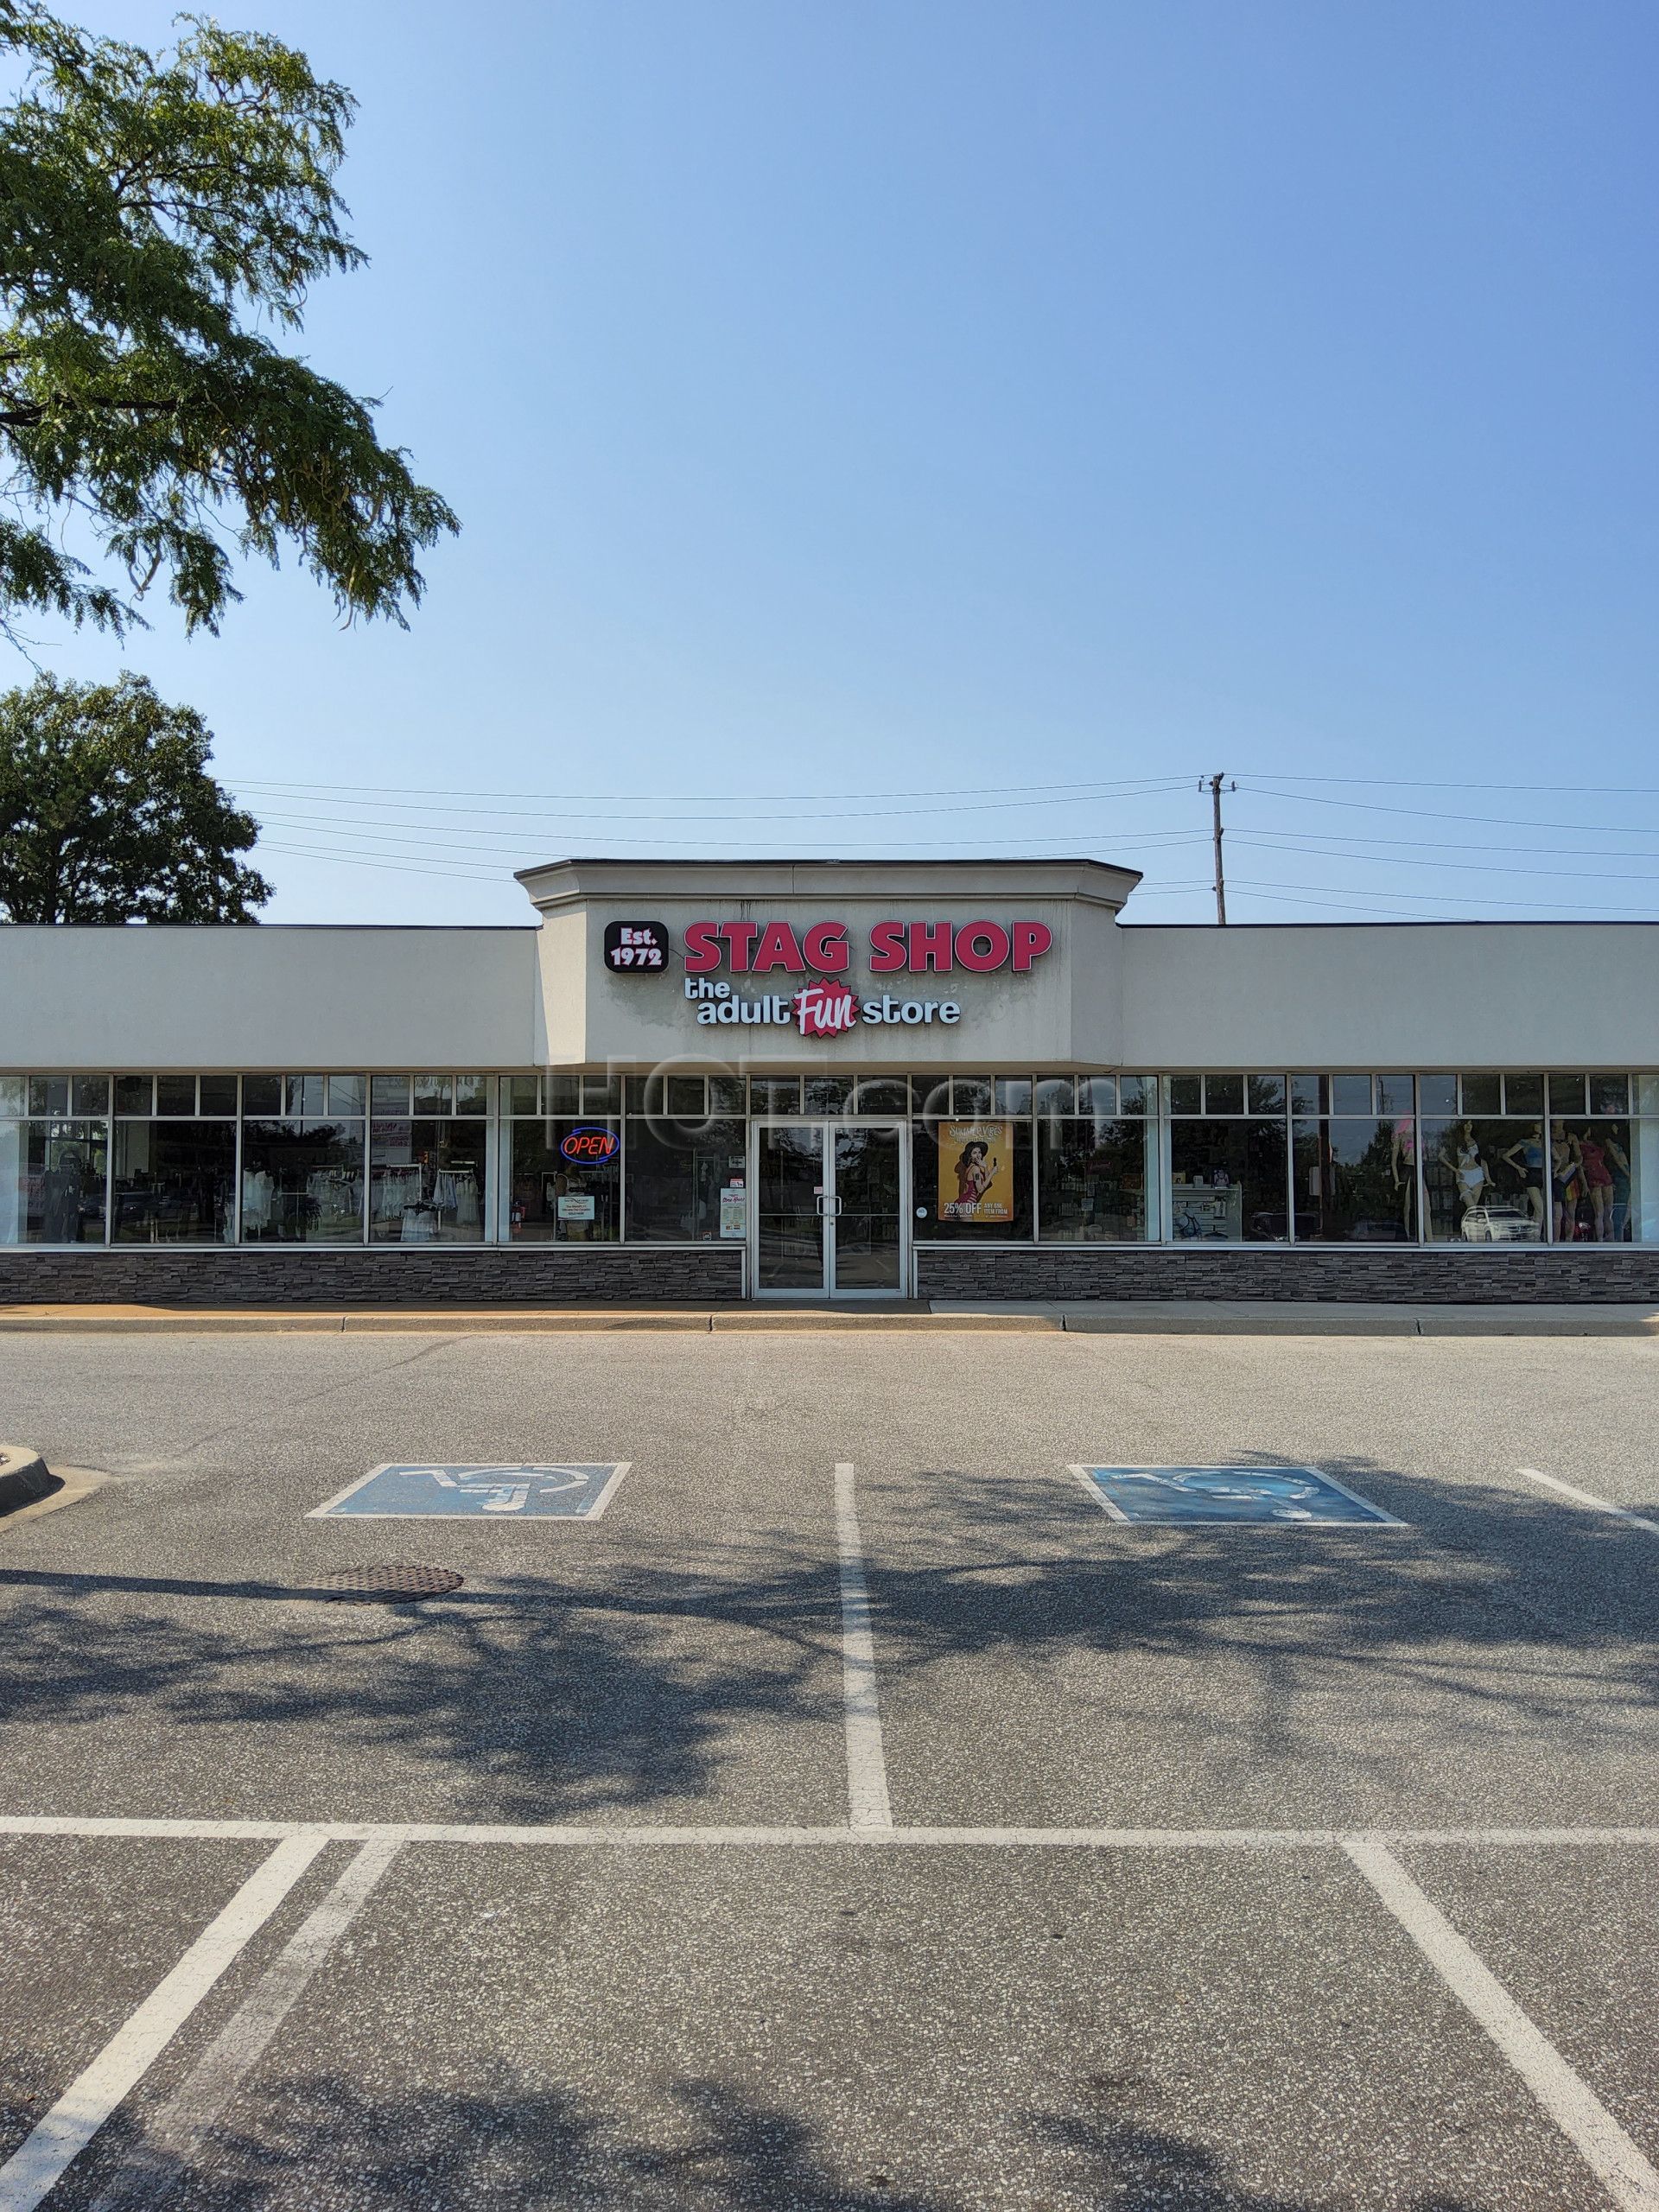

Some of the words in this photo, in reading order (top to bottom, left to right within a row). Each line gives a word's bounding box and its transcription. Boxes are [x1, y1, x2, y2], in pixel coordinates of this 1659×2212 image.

[620, 926, 658, 945] Est.
[610, 946, 663, 966] 1972
[683, 920, 849, 974] STAG
[869, 920, 1052, 973] SHOP
[684, 977, 731, 999] the
[696, 995, 791, 1025] adult
[792, 987, 858, 1036] Fun
[862, 995, 961, 1024] store
[564, 1136, 614, 1155] OPEN
[944, 1202, 963, 1214] 25%
[965, 1202, 982, 1214] OFF
